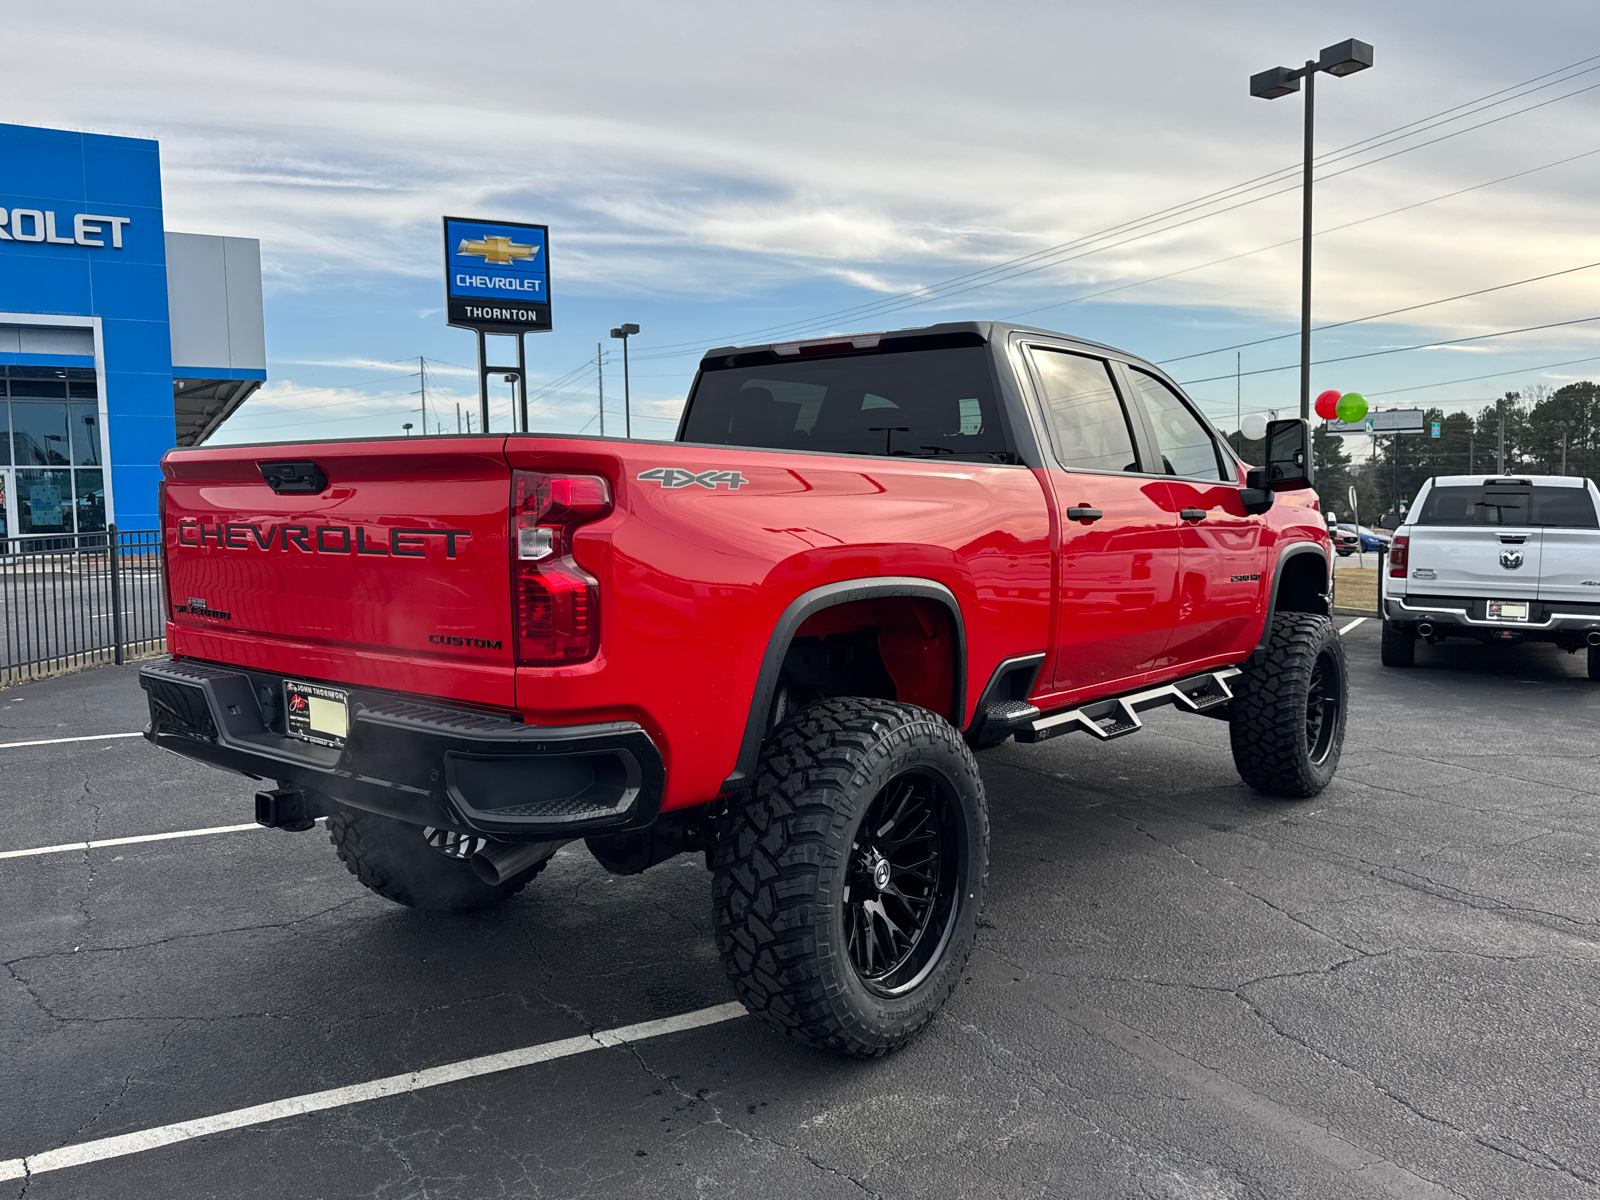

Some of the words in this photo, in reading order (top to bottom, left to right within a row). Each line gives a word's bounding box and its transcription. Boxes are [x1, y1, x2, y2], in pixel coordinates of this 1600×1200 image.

[456, 274, 541, 292] CHEVROLET
[465, 306, 537, 321] THORNTON
[178, 522, 472, 560] CHEVROLET
[428, 634, 503, 650] CUSTOM
[297, 685, 312, 694] JOHN
[312, 688, 344, 699] THORNTON
